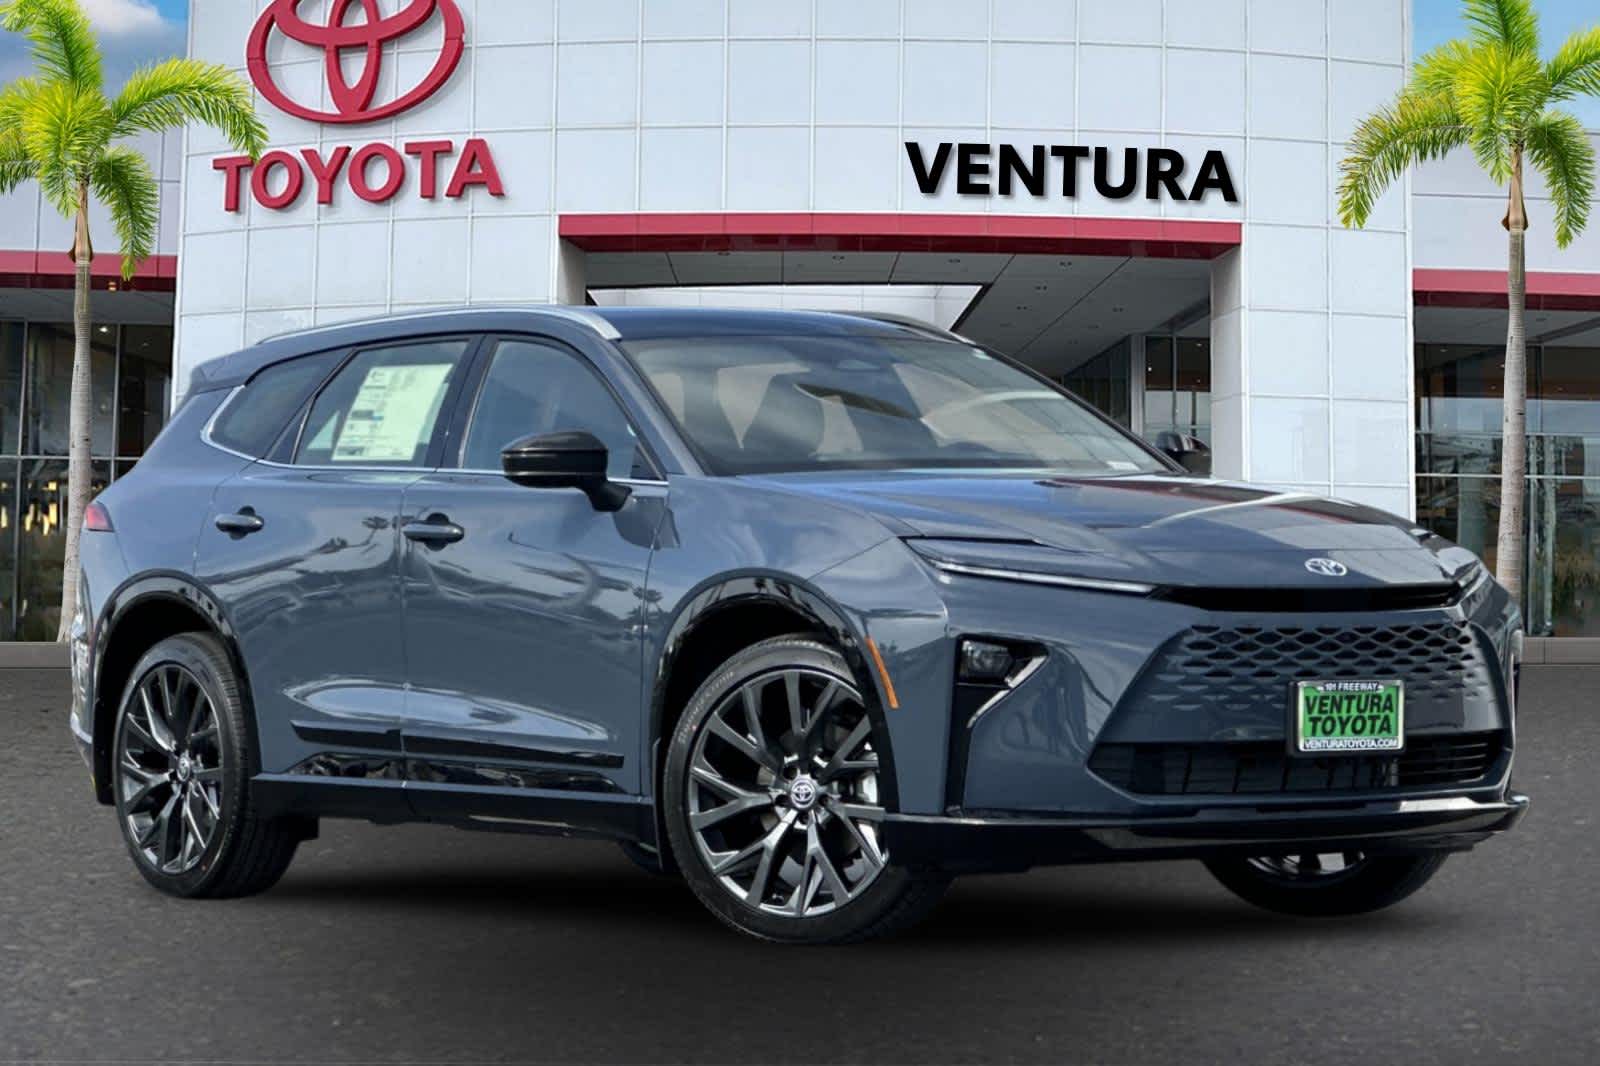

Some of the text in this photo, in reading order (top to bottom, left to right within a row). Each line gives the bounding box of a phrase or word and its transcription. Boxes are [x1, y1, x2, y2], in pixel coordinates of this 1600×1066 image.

[212, 138, 505, 212] TOYOTA
[904, 142, 1238, 203] VENTURA
[1338, 682, 1378, 691] FREEWAY
[1305, 693, 1394, 715] VENTURA
[1308, 715, 1392, 736] TOYOTA
